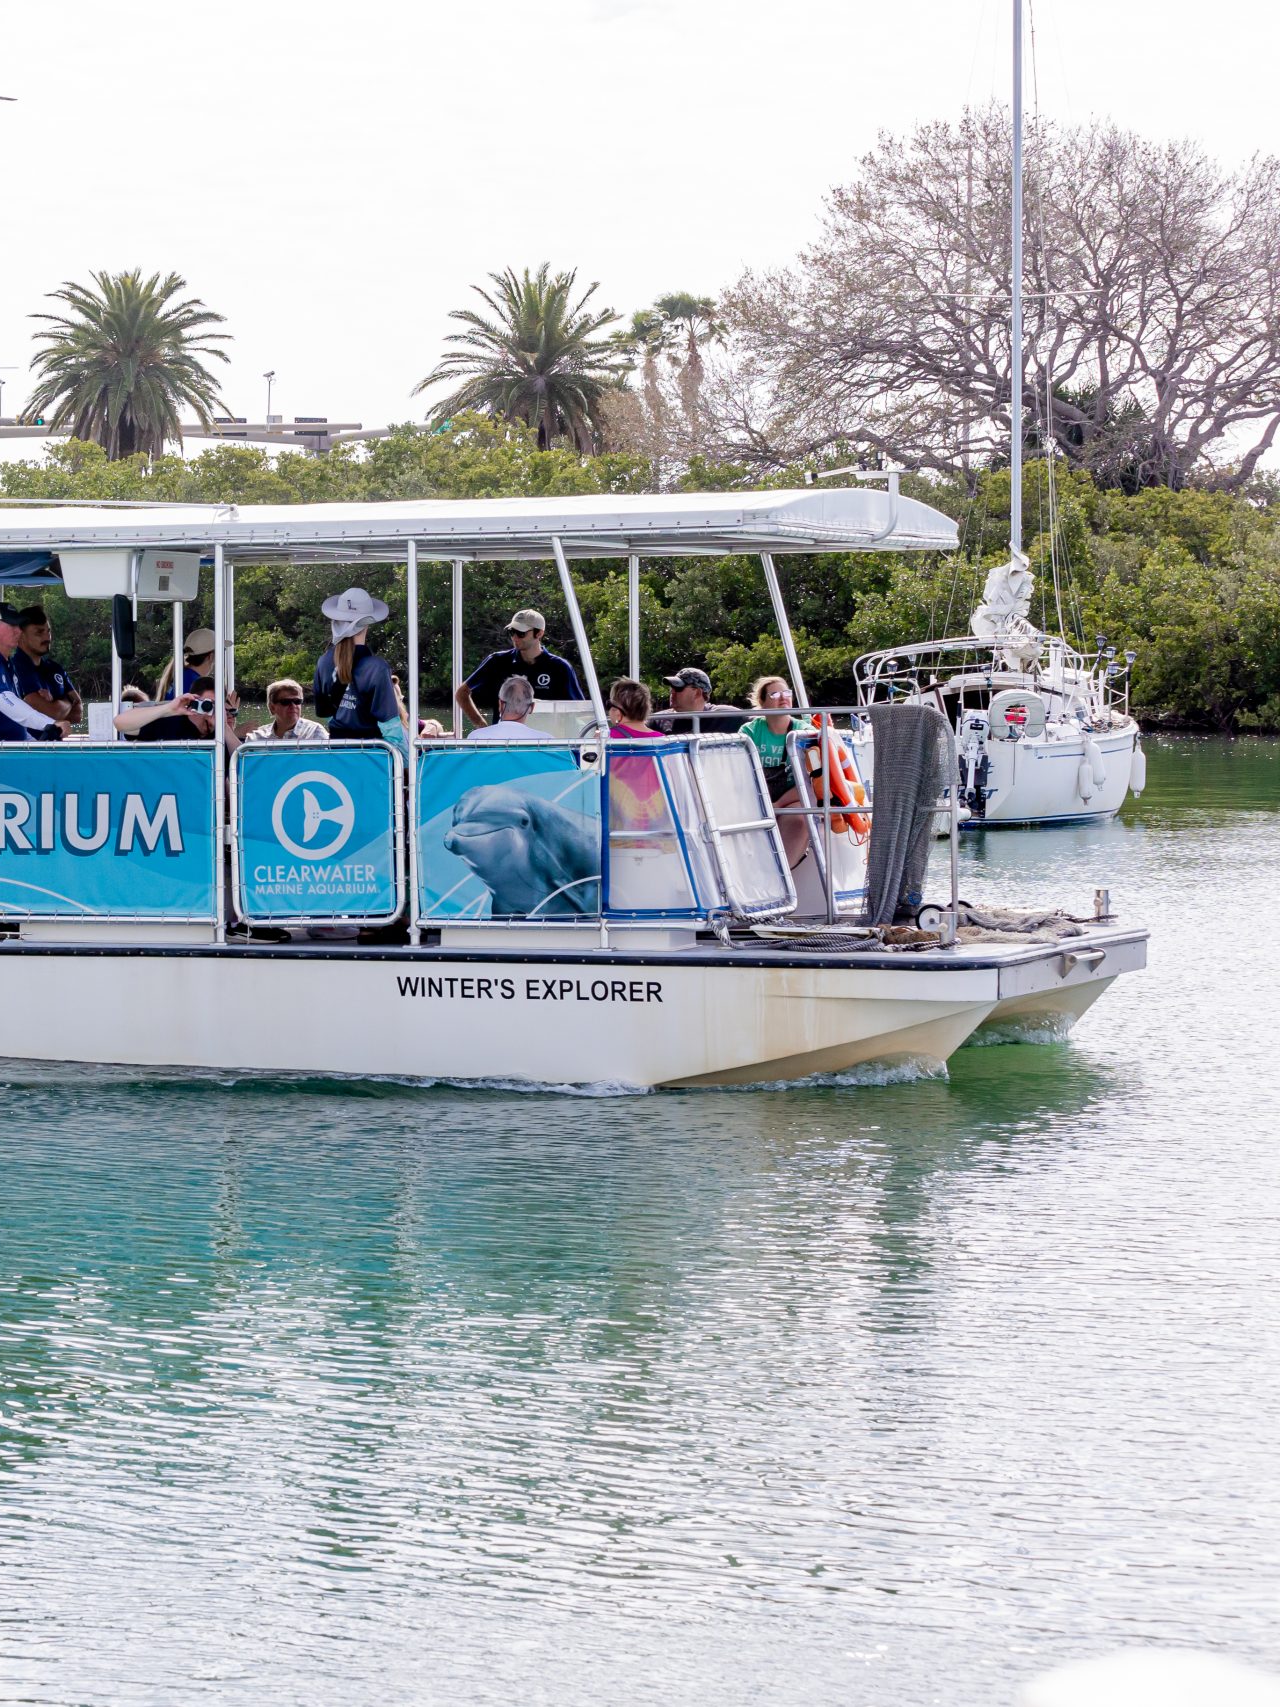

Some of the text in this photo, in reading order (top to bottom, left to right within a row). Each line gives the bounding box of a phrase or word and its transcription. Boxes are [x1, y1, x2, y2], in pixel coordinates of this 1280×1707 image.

[254, 864, 376, 883] CLEARWATER
[255, 883, 377, 895] MARINE AQUARIUM
[397, 976, 663, 1003] WINTER'S EXPLORER
